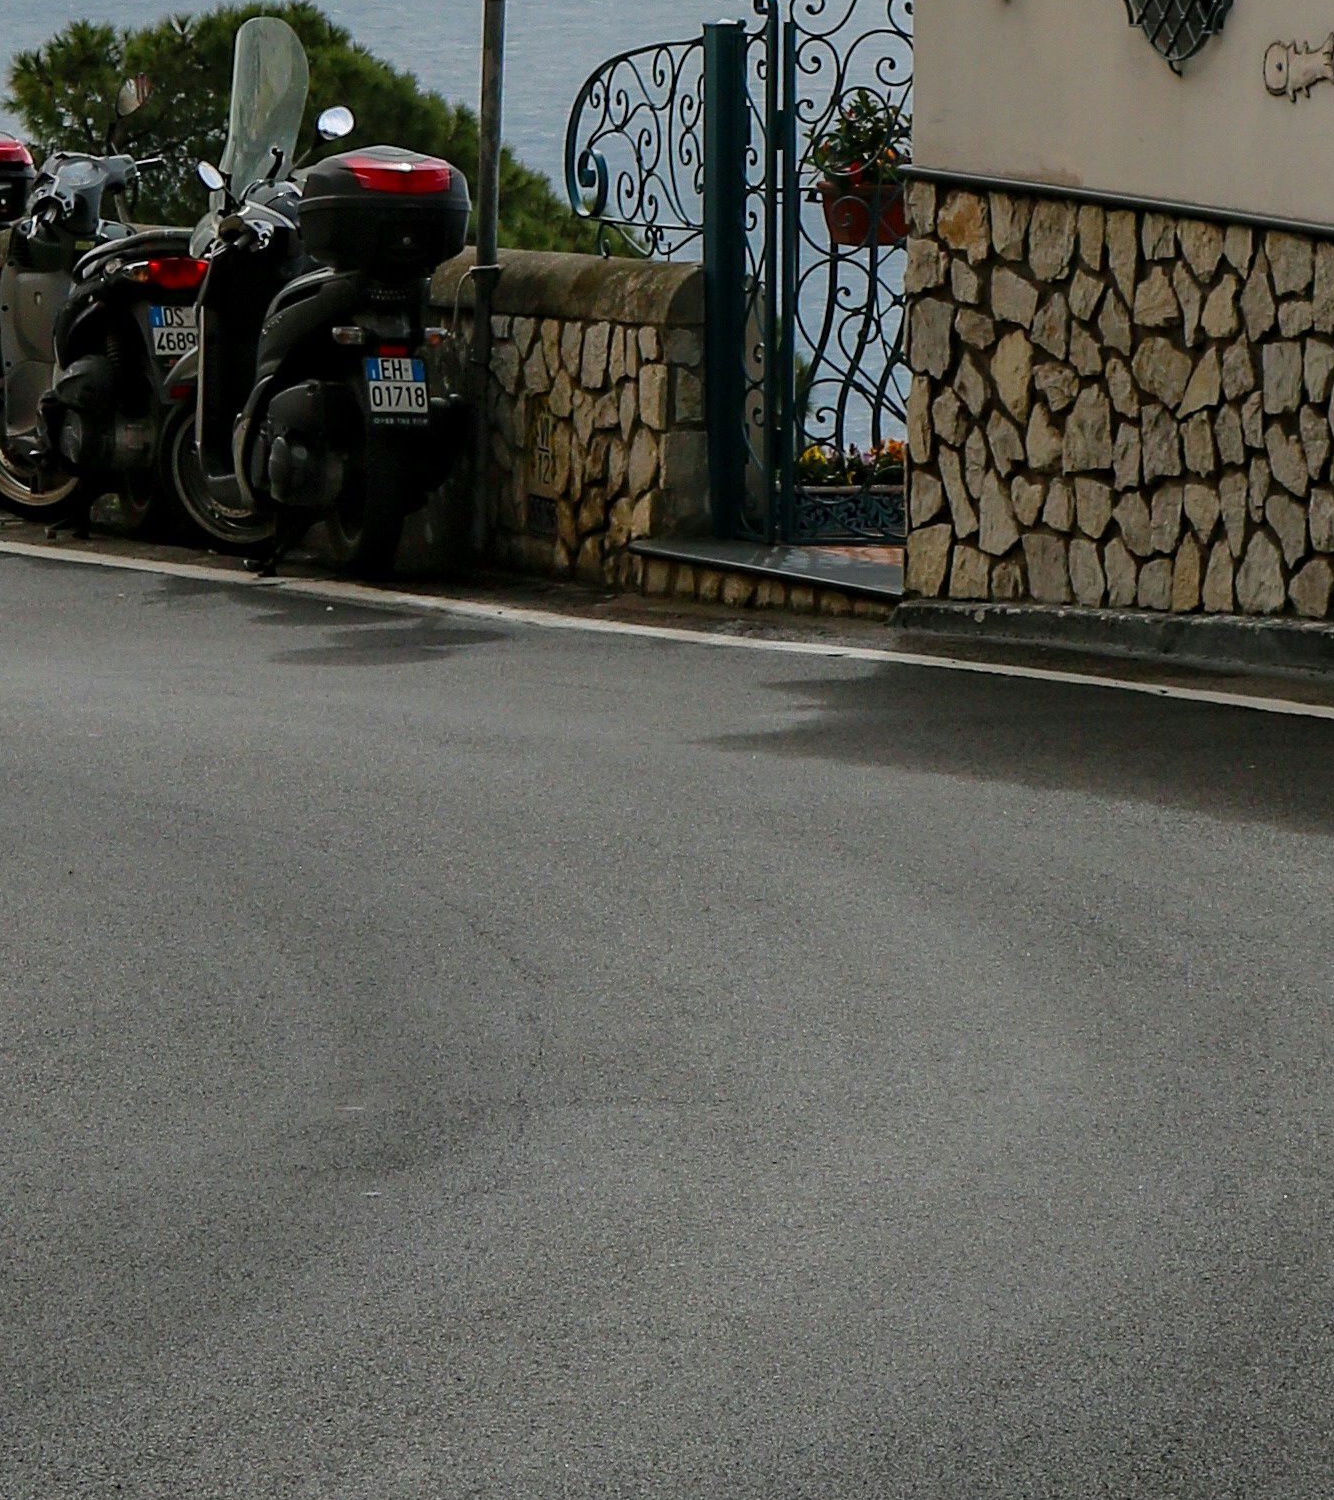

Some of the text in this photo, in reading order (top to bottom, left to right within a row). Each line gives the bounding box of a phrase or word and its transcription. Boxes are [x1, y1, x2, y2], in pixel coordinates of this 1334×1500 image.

[163, 307, 185, 327] DS
[380, 359, 403, 380] EH
[372, 386, 426, 408] 01718
